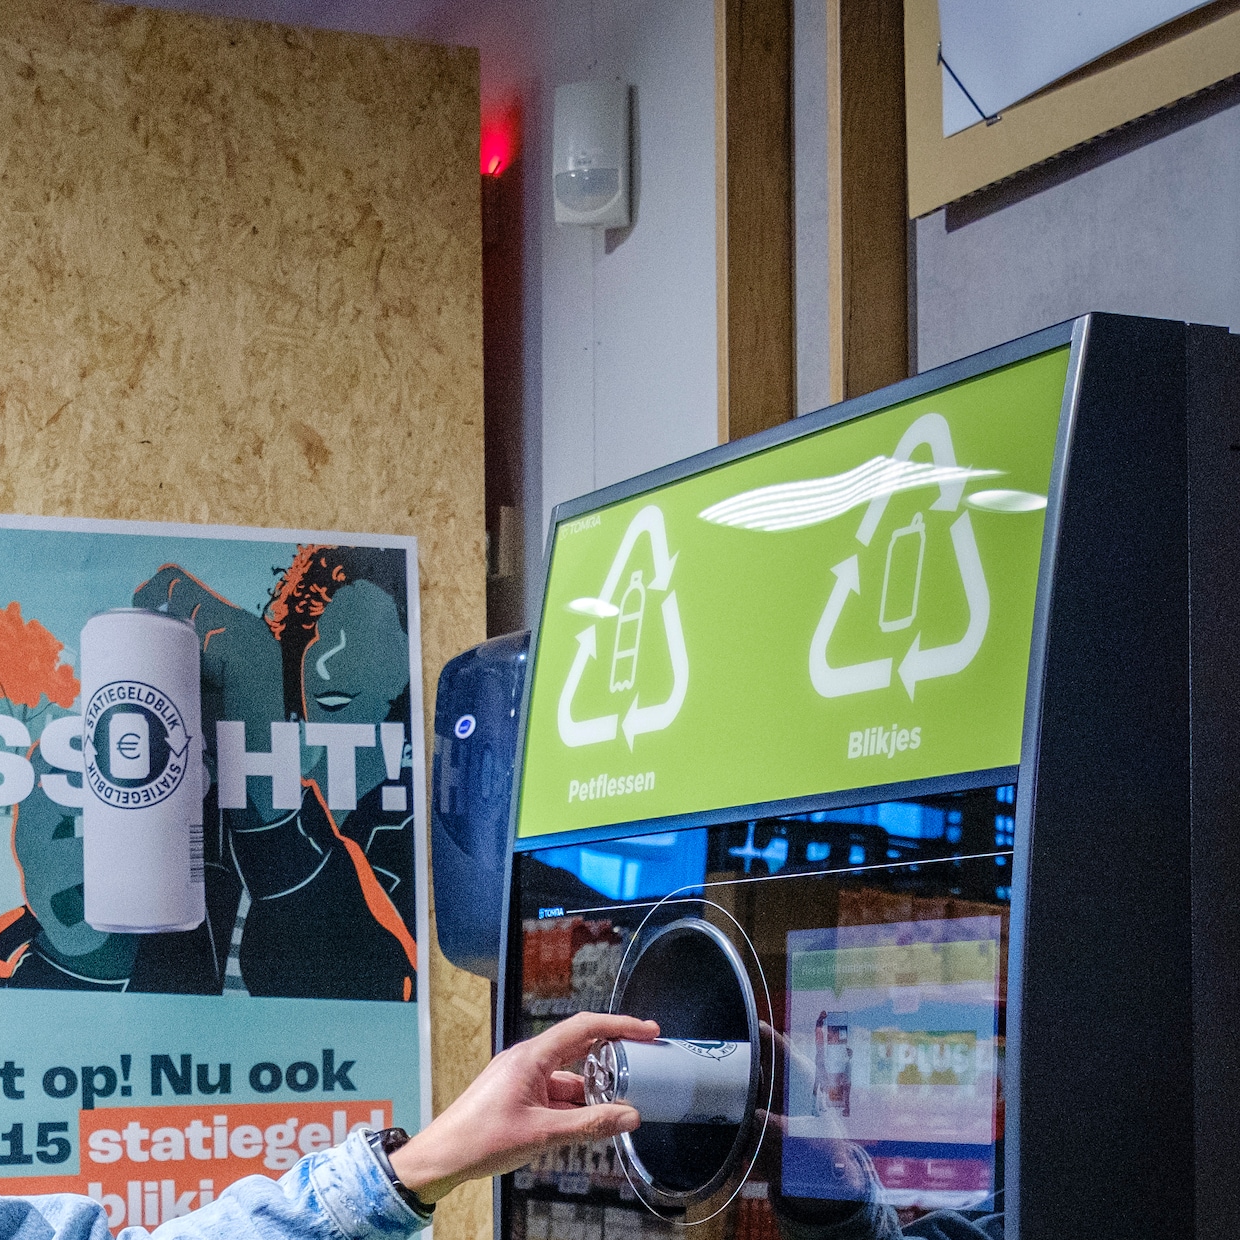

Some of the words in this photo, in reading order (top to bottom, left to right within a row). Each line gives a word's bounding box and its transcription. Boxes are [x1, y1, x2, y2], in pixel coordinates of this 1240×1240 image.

[86, 685, 182, 730] STATIEGELDBLIK
[846, 723, 923, 761] Blikjes
[86, 762, 182, 805] STATIEGELDBLIK
[567, 770, 656, 804] Petflessen
[42, 1054, 133, 1111] op!
[150, 1053, 232, 1097] Nu
[248, 1048, 358, 1093] ook
